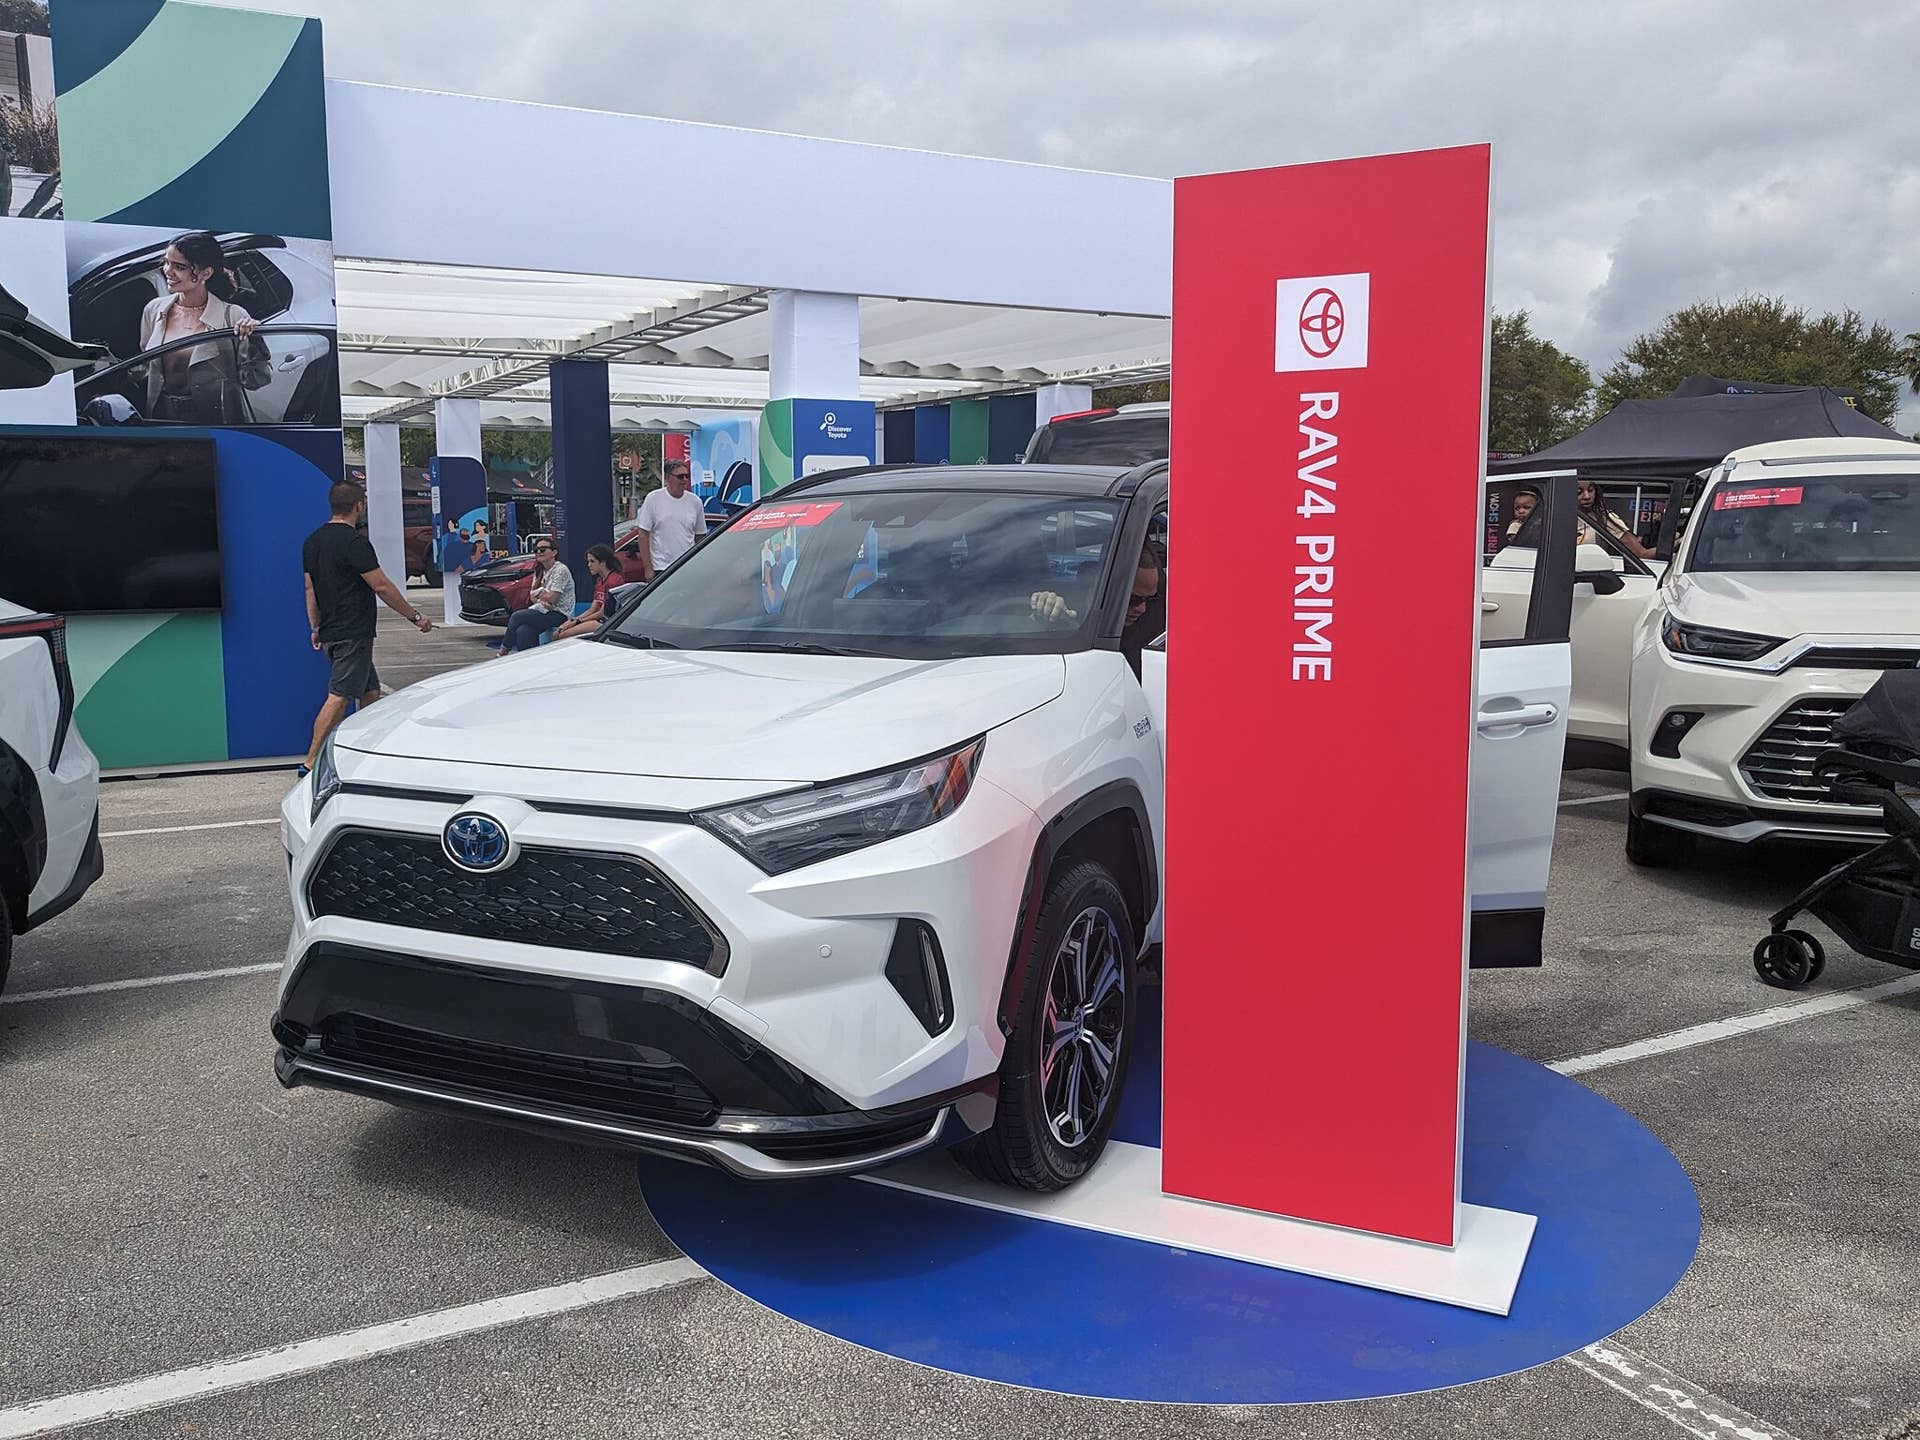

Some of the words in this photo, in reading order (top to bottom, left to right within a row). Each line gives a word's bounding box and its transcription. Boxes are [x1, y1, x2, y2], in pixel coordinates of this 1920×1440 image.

[827, 432, 848, 440] Toyota
[1296, 391, 1340, 519] RAV4
[1488, 492, 1500, 522] SHOW
[1487, 527, 1499, 554] TRIFY
[1292, 535, 1335, 681] PRIME
